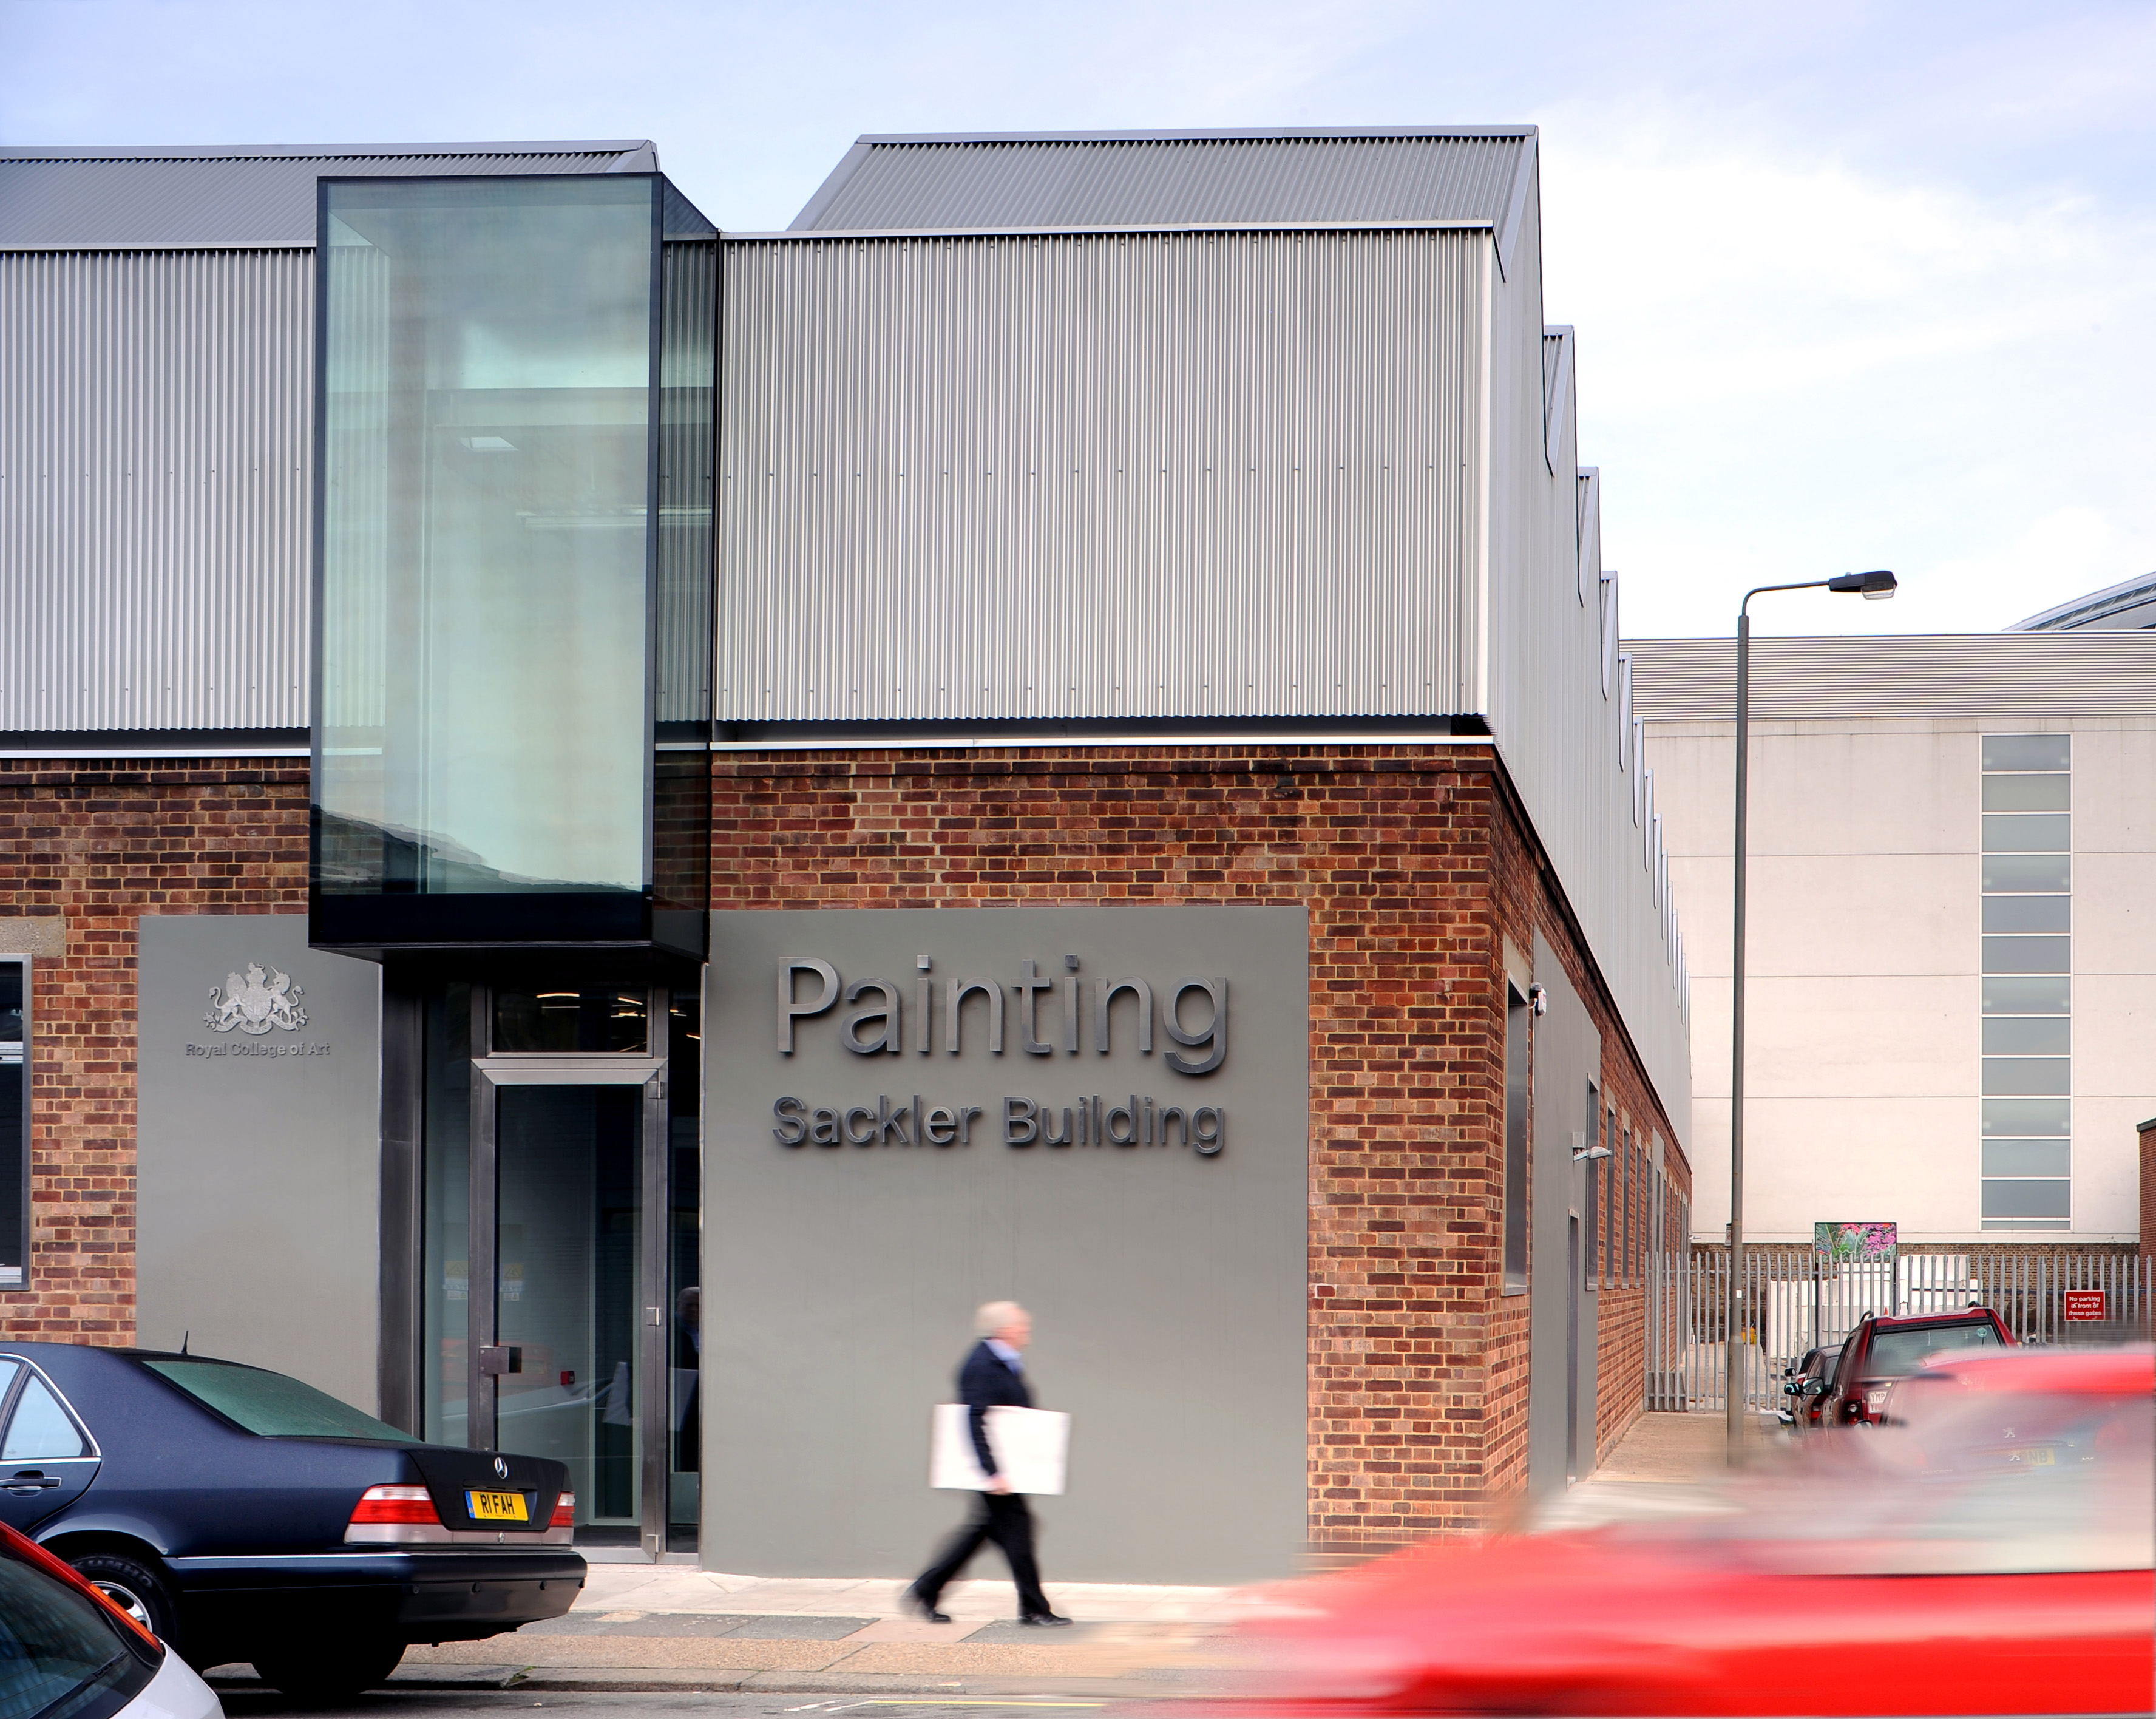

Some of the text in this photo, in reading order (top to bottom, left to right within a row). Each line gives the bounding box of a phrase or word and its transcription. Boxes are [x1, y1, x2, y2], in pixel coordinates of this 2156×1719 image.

[778, 954, 1228, 1075] Painting
[185, 1042, 330, 1058] Royal College of Art
[772, 1094, 1225, 1154] Sackler Building
